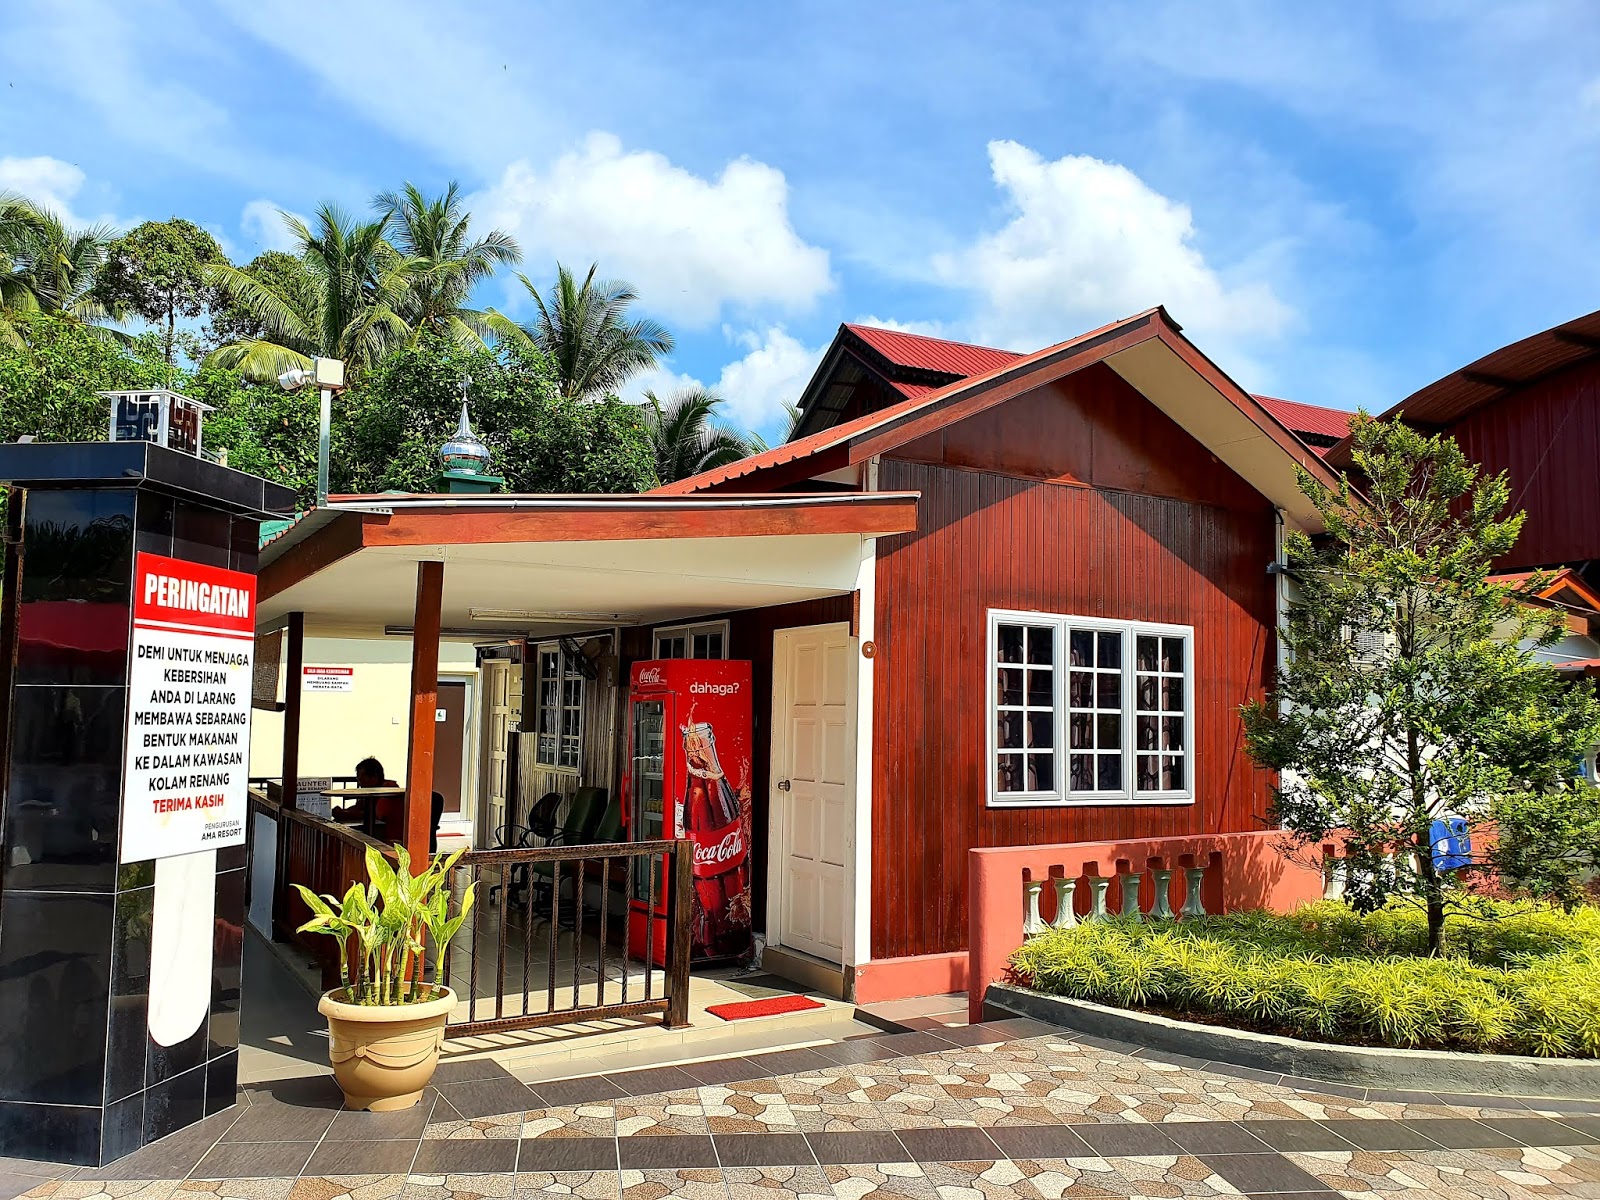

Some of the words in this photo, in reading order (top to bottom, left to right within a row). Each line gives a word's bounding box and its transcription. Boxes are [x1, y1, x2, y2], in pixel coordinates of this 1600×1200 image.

[144, 573, 249, 618] PERINGATAN
[138, 644, 164, 660] DEMI
[167, 647, 202, 663] UNTUK
[205, 650, 249, 666] MENJAGA
[163, 668, 226, 684] KEBERSIHAN
[150, 689, 181, 704] ANDA
[184, 691, 194, 704] DI
[197, 691, 236, 705] LARANG
[689, 682, 740, 696] dahaga?
[134, 711, 193, 726] MEMBAWA
[195, 712, 246, 725] SEBARANG
[143, 733, 186, 748] BENTUK
[189, 732, 238, 746] MAKANAN
[135, 756, 150, 770] KE
[152, 754, 190, 770] DALAM
[193, 752, 243, 767] KAWASAN
[149, 776, 187, 791] KOLAM
[189, 773, 230, 788] RENANG
[153, 797, 192, 813] TERIMA
[195, 793, 224, 809] KASIH
[205, 820, 240, 830] PENGURUSAN
[201, 831, 216, 841] AMA
[217, 828, 242, 838] RESORT
[693, 828, 742, 865] Coca-Cola
